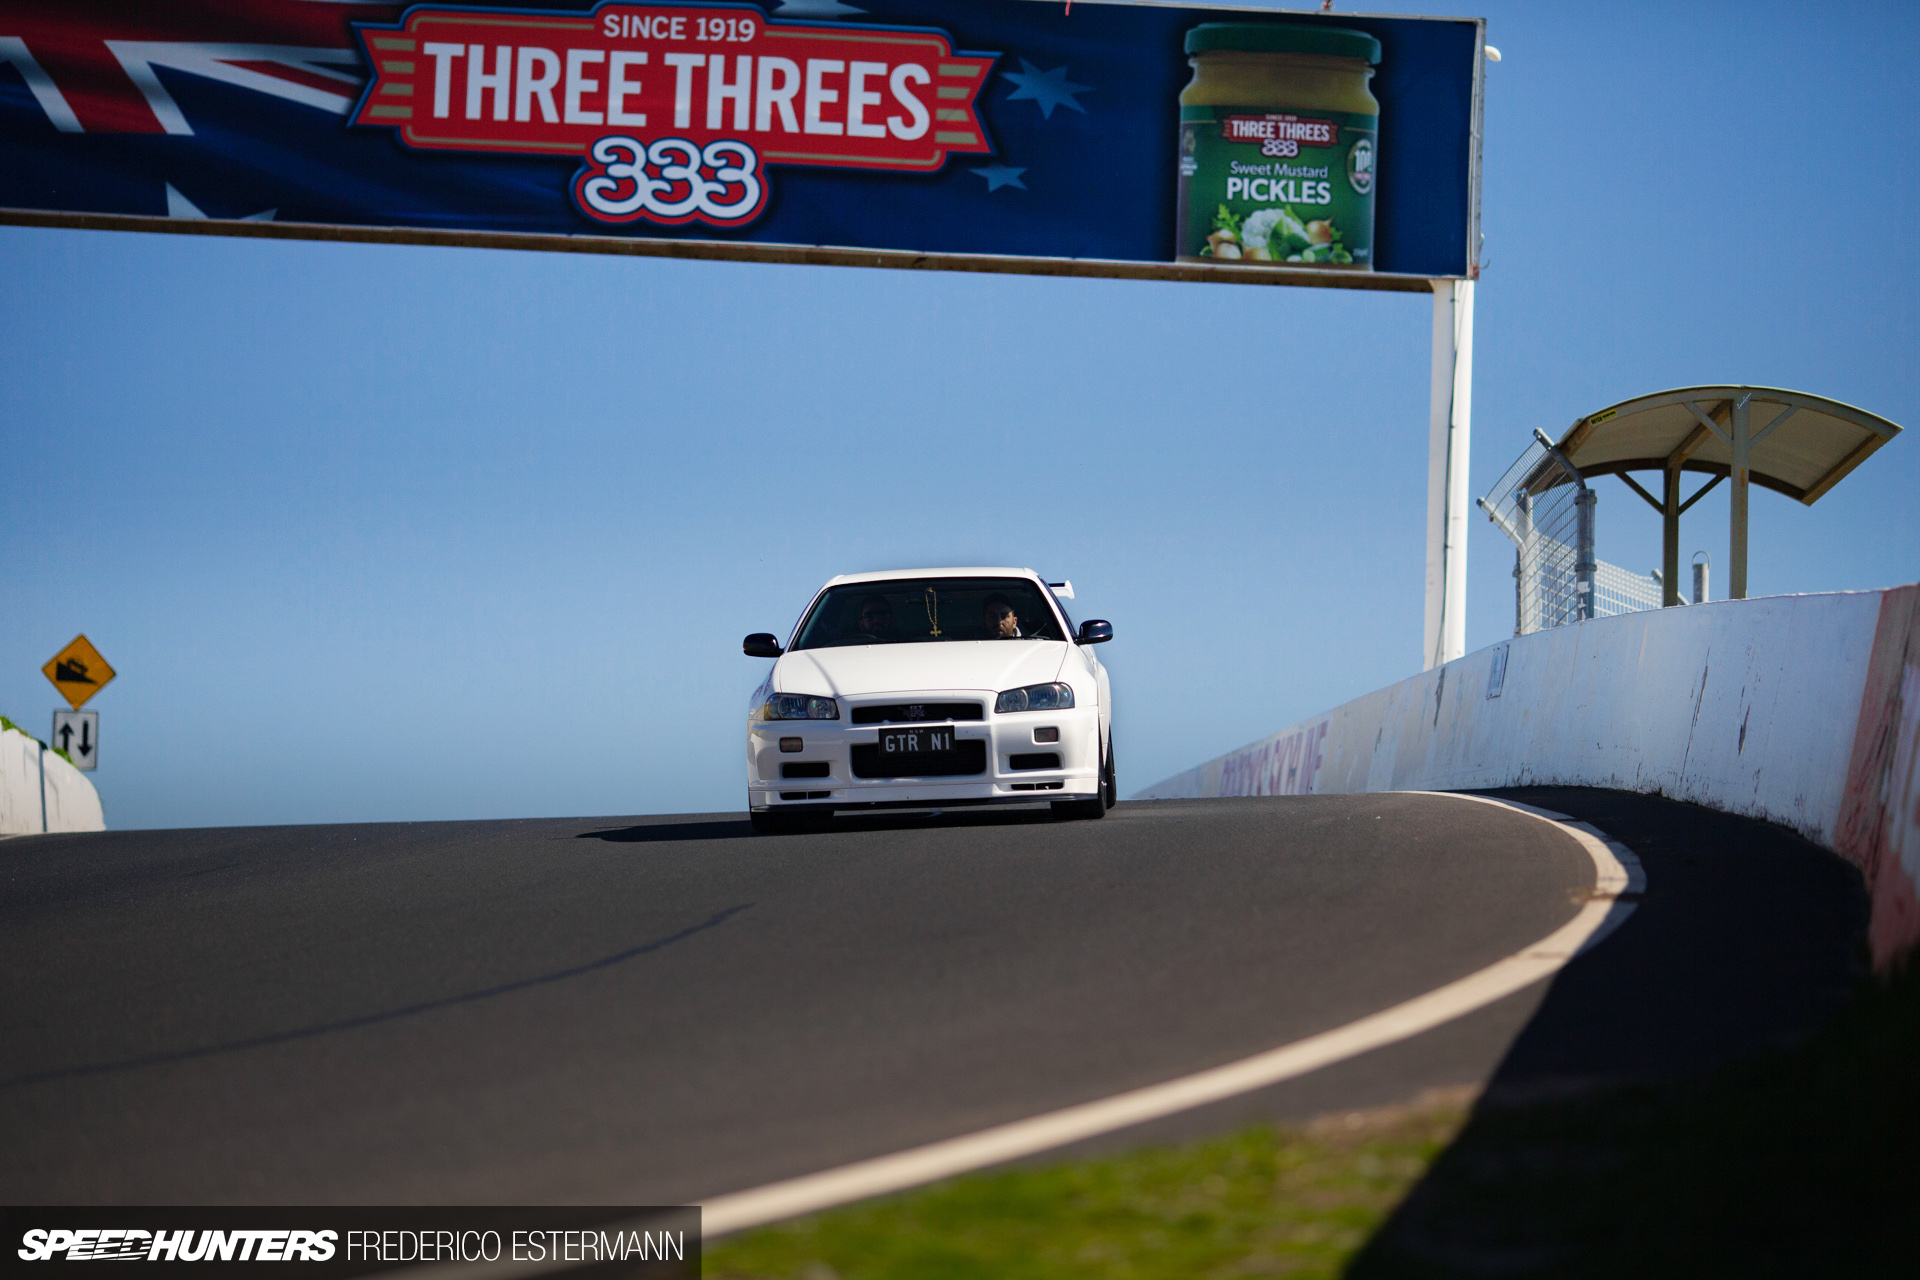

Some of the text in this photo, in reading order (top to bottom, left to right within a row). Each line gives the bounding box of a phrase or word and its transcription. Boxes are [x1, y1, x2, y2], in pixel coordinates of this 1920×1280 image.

[603, 14, 756, 43] SINCE 1919
[423, 42, 932, 141] THREE THREES
[1231, 120, 1330, 142] THREE THREES
[584, 136, 761, 218] 333
[1230, 160, 1328, 179] Sweet Mustard
[1227, 176, 1331, 205] PICKLES
[885, 732, 950, 752] GTR N1
